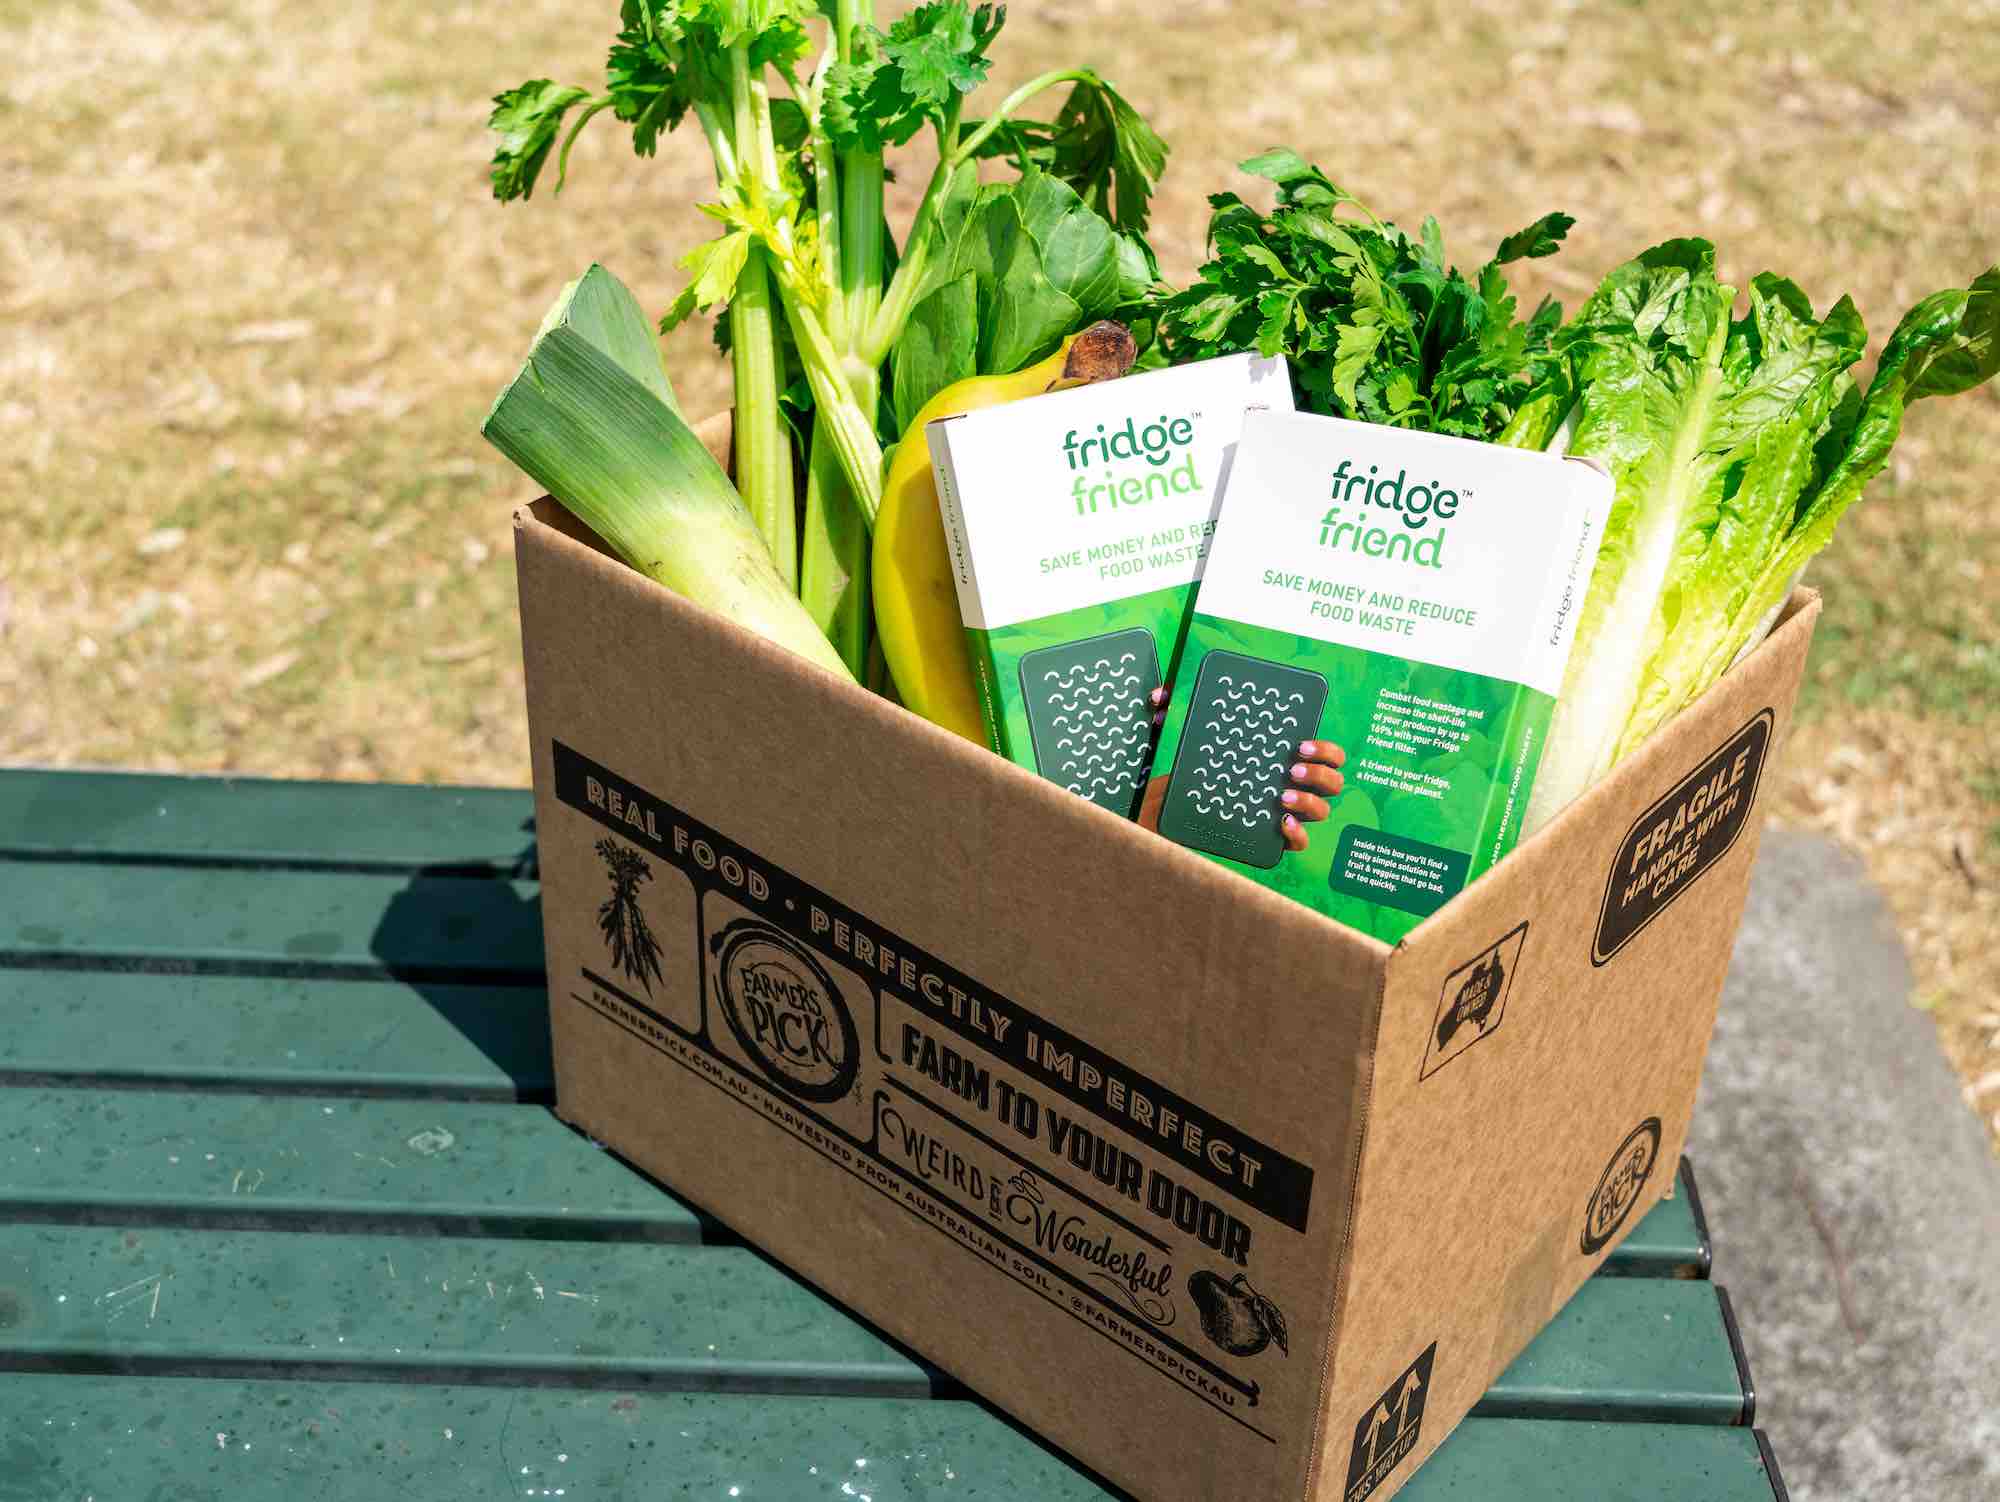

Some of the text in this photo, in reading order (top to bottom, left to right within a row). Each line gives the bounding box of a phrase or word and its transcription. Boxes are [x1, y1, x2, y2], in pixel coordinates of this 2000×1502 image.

[1062, 415, 1193, 469] fridge
[1071, 453, 1203, 515] friend
[1331, 461, 1459, 528] fridge
[1039, 551, 1082, 573] SAVE
[1087, 536, 1145, 563] MONEY
[1151, 527, 1185, 546] AND
[1099, 543, 1206, 581] FOOD WASTE
[1319, 507, 1446, 569] friend
[1263, 569, 1477, 627] SAVE MONEY AND REDUCE
[1310, 600, 1416, 636] FOOD WASTE
[1376, 699, 1412, 715] increase
[1412, 707, 1426, 719] the
[1380, 688, 1484, 719] Combat food wastage and
[1382, 716, 1402, 726] your
[1402, 719, 1437, 734] produce
[1366, 735, 1394, 749] Friend
[1393, 729, 1412, 740] with
[1412, 735, 1432, 745] your
[1433, 738, 1460, 752] Fridge
[1363, 772, 1389, 785] friend
[1400, 781, 1414, 792] the
[1367, 760, 1393, 773] friend
[1402, 770, 1424, 781] your
[1630, 744, 1751, 874] FRAGILE
[1347, 859, 1365, 871] fruit
[1372, 868, 1400, 882] veggies
[1401, 874, 1417, 886] that
[1350, 850, 1441, 880] really simple solution for
[1353, 838, 1376, 850] Inside
[1376, 844, 1391, 855] this
[1392, 848, 1406, 859] box
[1427, 858, 1443, 870] find
[1621, 787, 1740, 909] HANDLE WITH
[1652, 844, 1699, 899] CARE
[586, 775, 1262, 1189] REAL FOOD PERFECTLY IMPERFECT
[739, 968, 822, 1018] FARMERS
[746, 996, 841, 1069] PICK
[901, 1023, 1252, 1267] FARM TO YOUR DOOR
[593, 992, 1236, 1408] FARMERSPICK.COM.AU HARVESTED FROM AUSTRALIAN SOIL @FARMERSPICKAU
[880, 1107, 984, 1201] WEIRD
[1006, 1193, 1173, 1297] Wonderful
